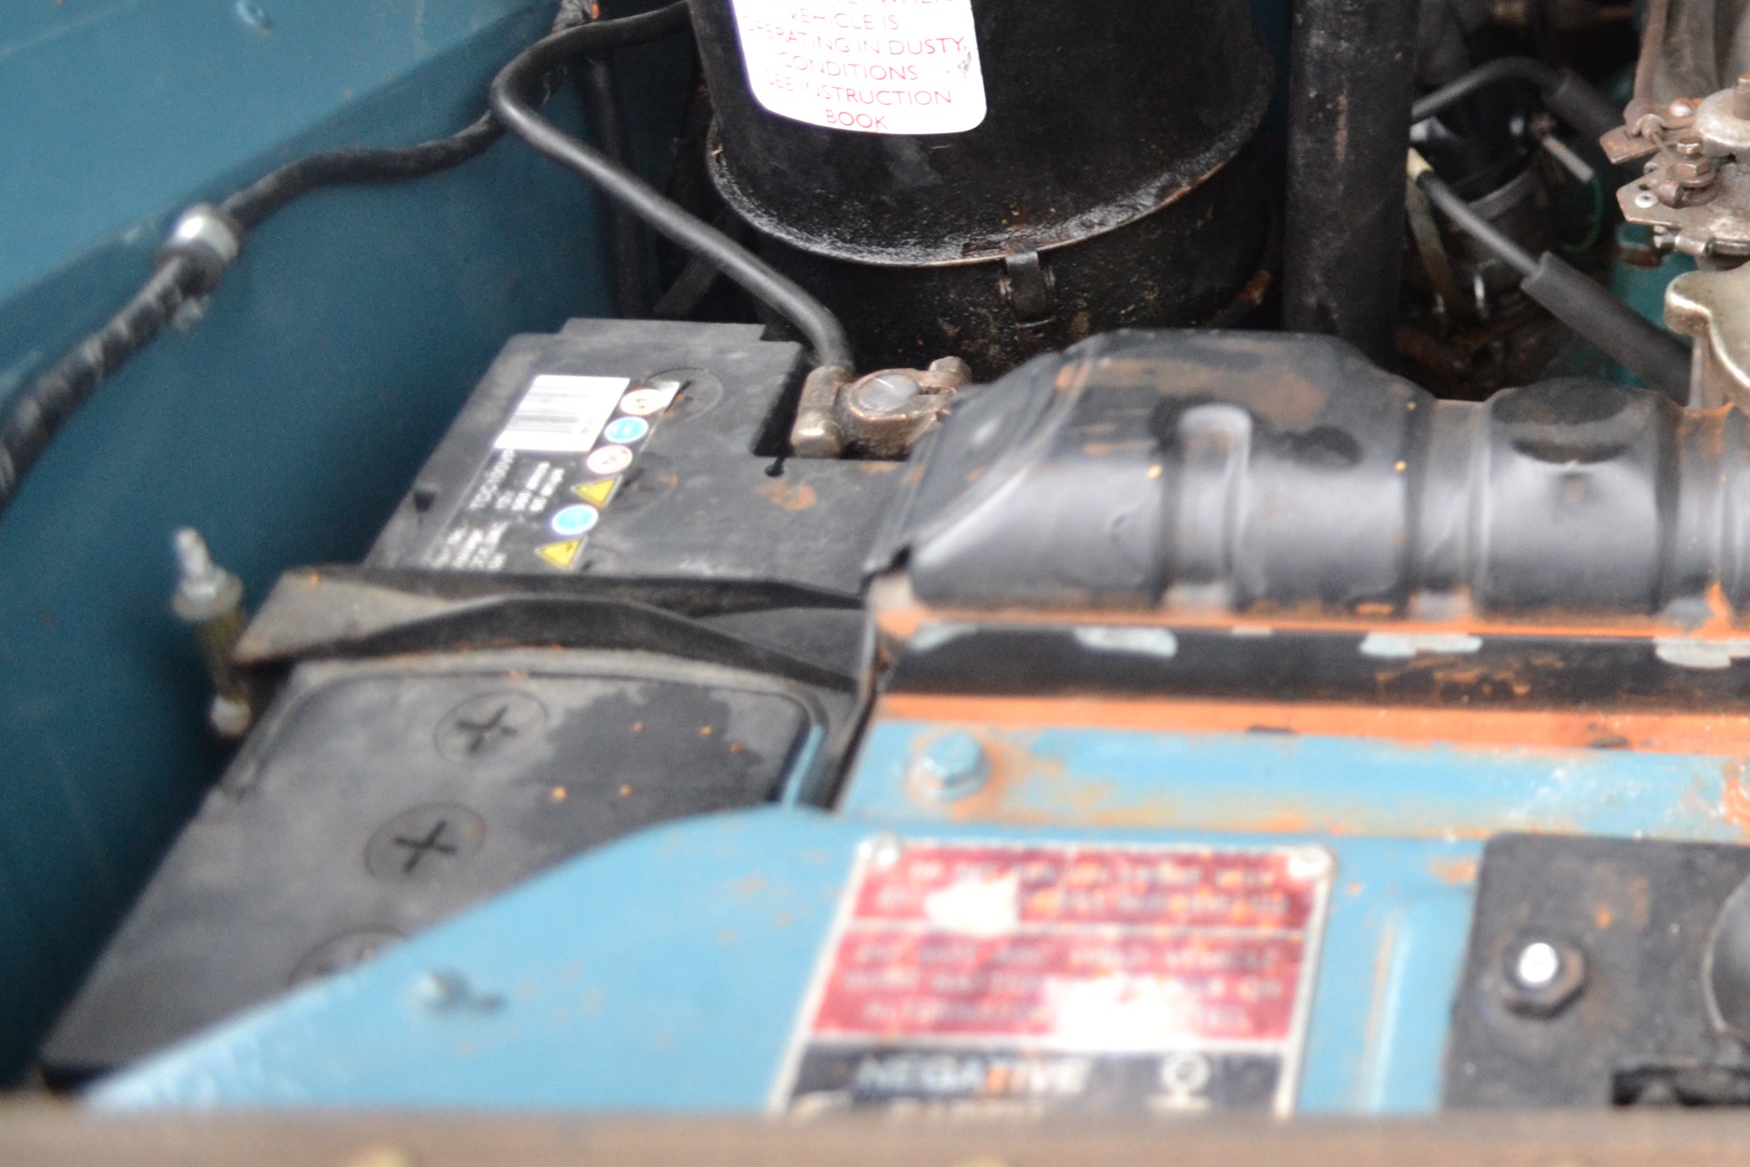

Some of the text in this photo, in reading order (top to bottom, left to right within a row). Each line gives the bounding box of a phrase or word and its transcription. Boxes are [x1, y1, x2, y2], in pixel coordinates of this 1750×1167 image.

[790, 8, 899, 30] VEHICLE IS
[858, 39, 880, 54] IN
[888, 37, 964, 55] DUSTY
[779, 52, 918, 80] CONDITIONS
[801, 82, 952, 106] INSTRUCTION
[825, 109, 887, 129] BOOK
